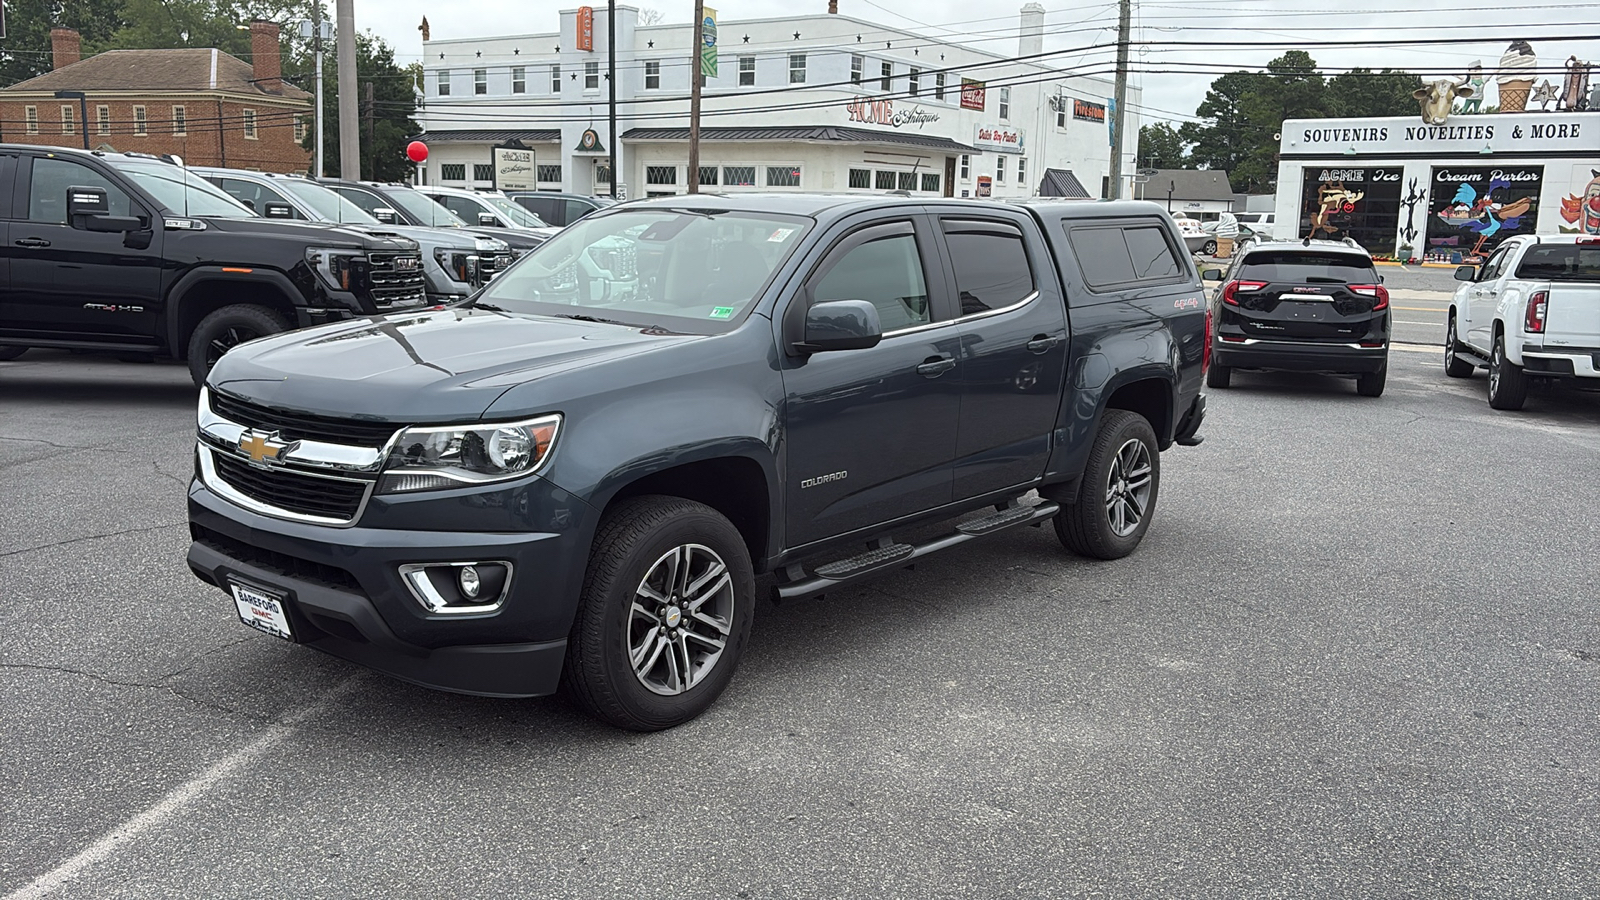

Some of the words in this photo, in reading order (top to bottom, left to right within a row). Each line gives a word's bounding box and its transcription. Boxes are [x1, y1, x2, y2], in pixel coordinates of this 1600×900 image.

[847, 95, 893, 126] ACME
[892, 104, 940, 130] Antiques
[993, 130, 1002, 144] Boy
[1303, 127, 1388, 143] SOUVENIRS
[1405, 125, 1495, 141] NOVELTIES
[1511, 124, 1523, 139] &
[1530, 123, 1581, 139] MORE
[1318, 169, 1364, 182] ACME
[1372, 169, 1400, 182] Ice
[1436, 169, 1483, 182] Cream
[1489, 169, 1540, 181] Parlor
[617, 192, 626, 200] 25
[1293, 286, 1321, 294] GMC
[801, 470, 848, 489] COLORADO
[237, 590, 280, 614] BAREFORD
[251, 606, 274, 621] GMC
